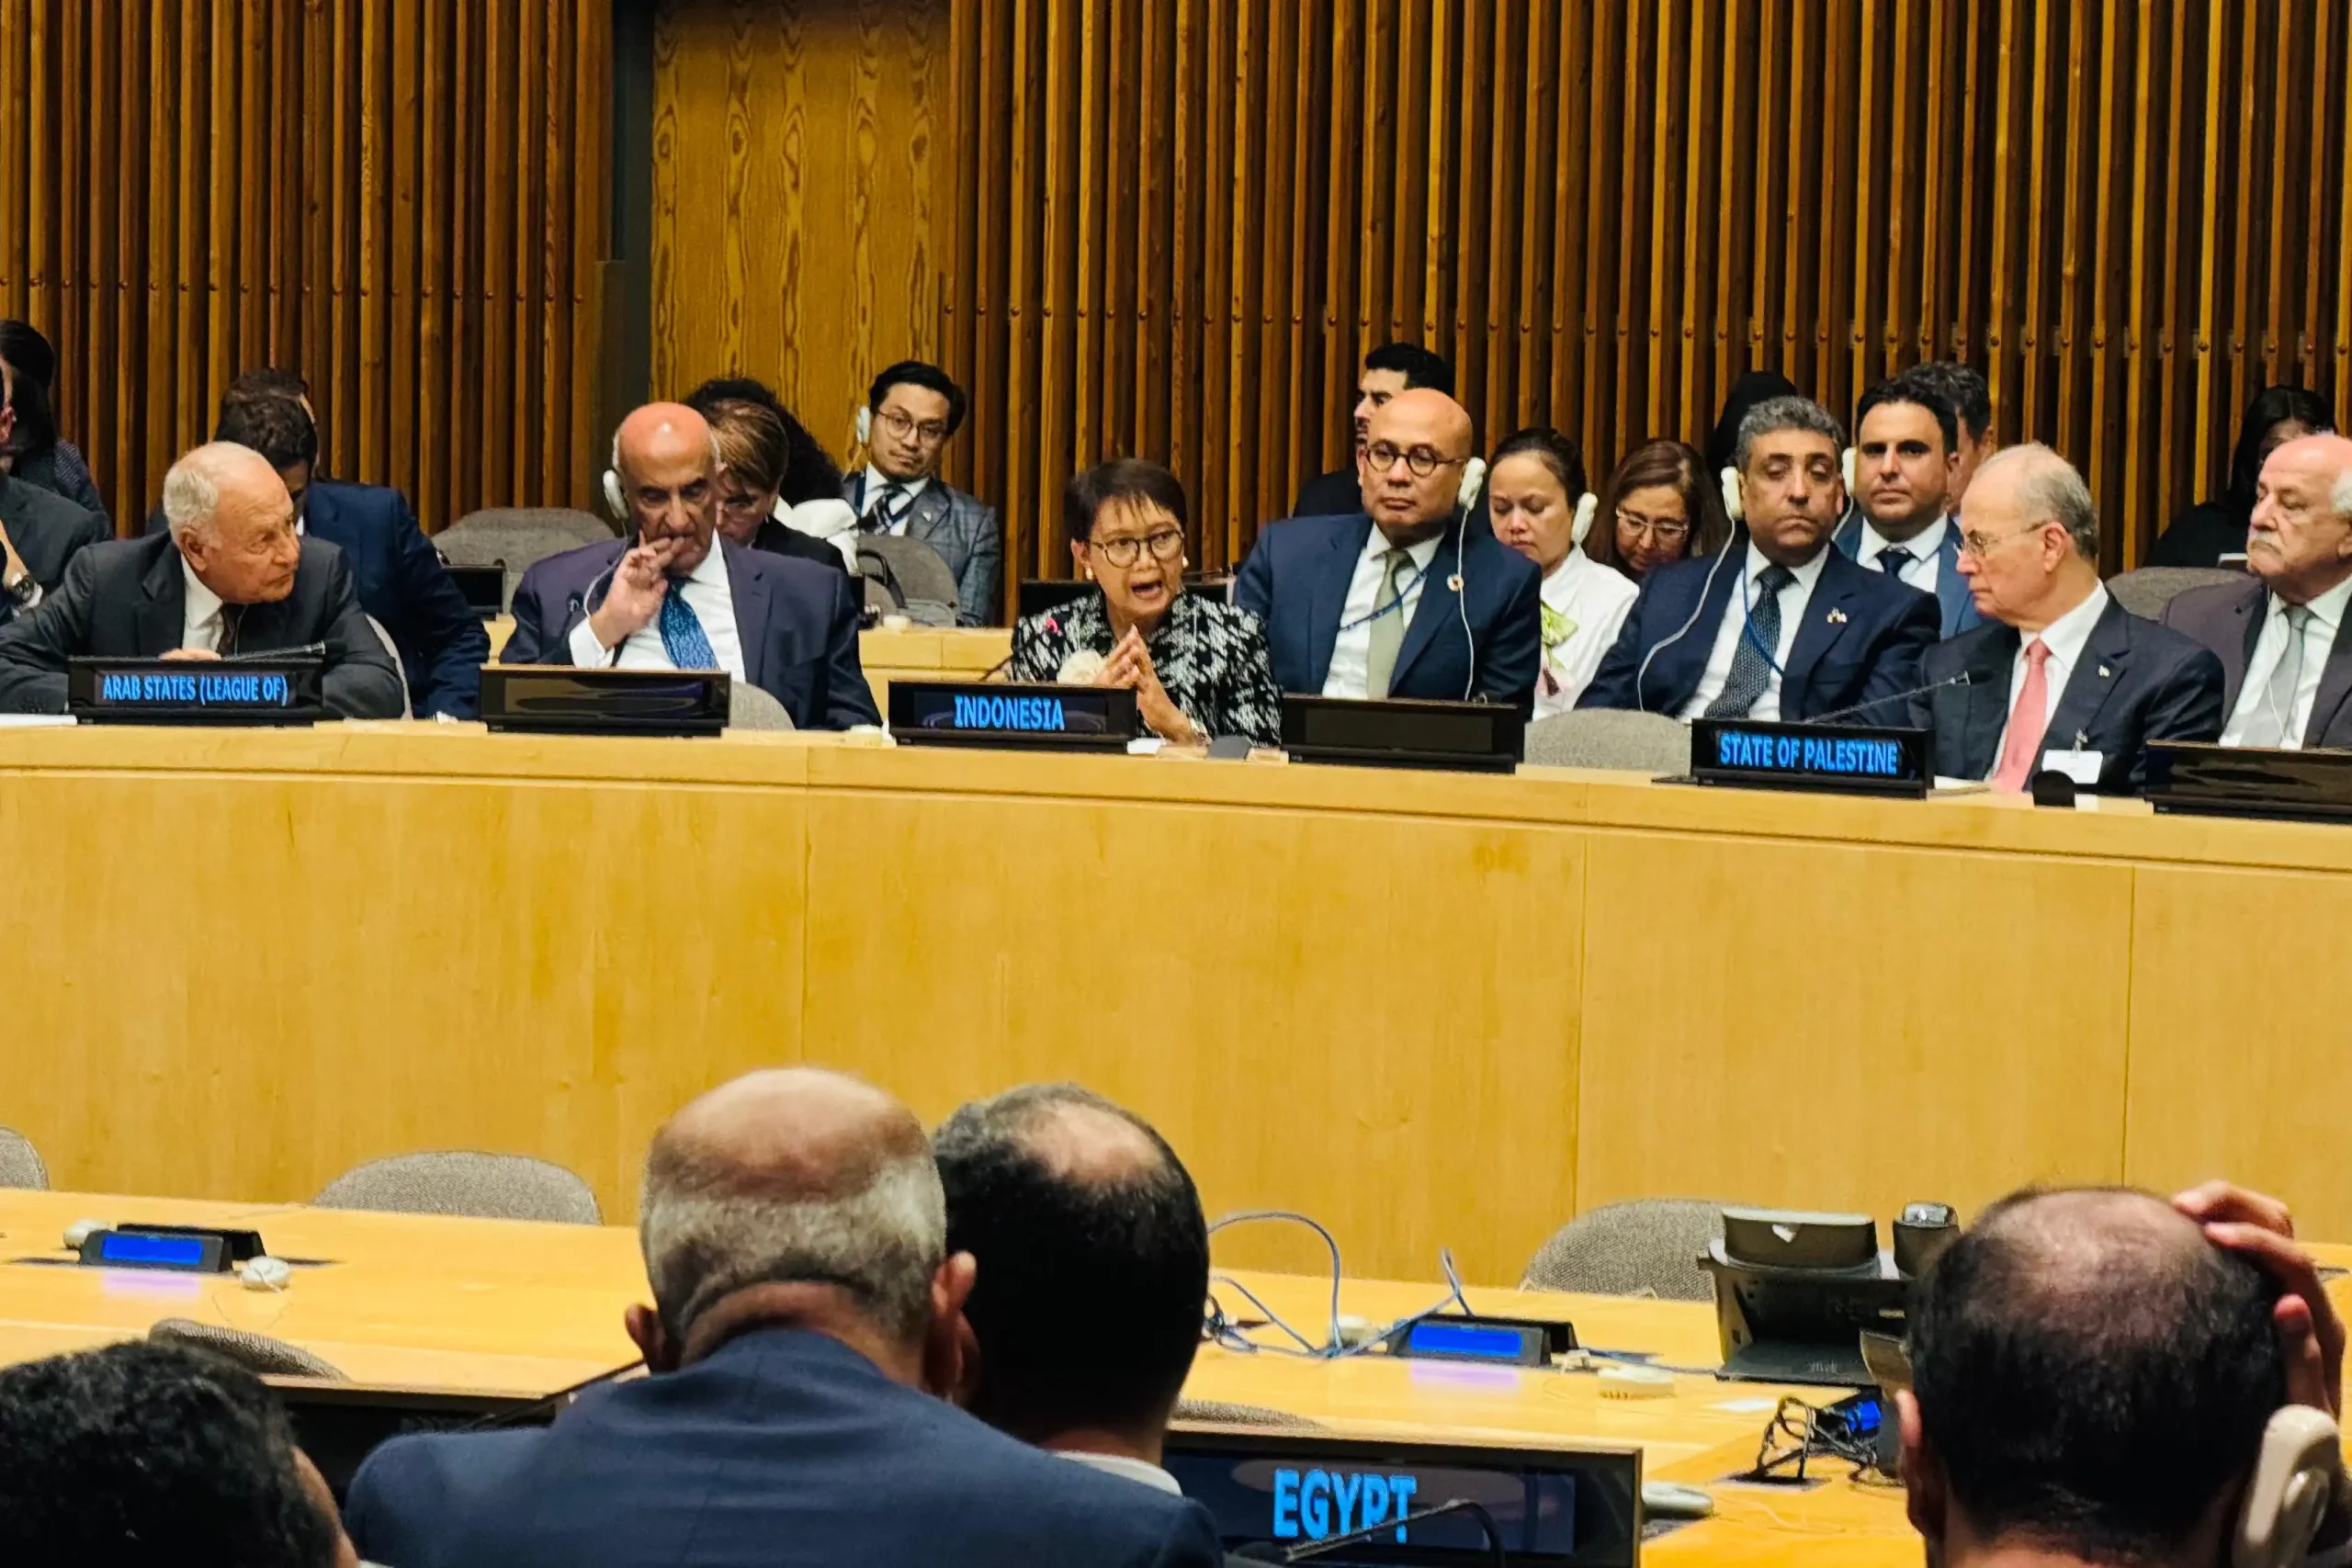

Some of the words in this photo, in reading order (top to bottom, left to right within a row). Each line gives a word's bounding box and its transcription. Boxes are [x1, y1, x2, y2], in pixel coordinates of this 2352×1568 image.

[103, 675, 141, 701] ARAB
[143, 675, 195, 701] STATES
[198, 674, 259, 705] (LEAGUE
[262, 675, 288, 706] OF)
[954, 695, 1065, 731] INDONESIA
[1719, 732, 1773, 767] STATE
[1777, 737, 1800, 768] OF
[1803, 738, 1899, 775] PALESTINE
[1273, 1468, 1418, 1544] EGYPT
